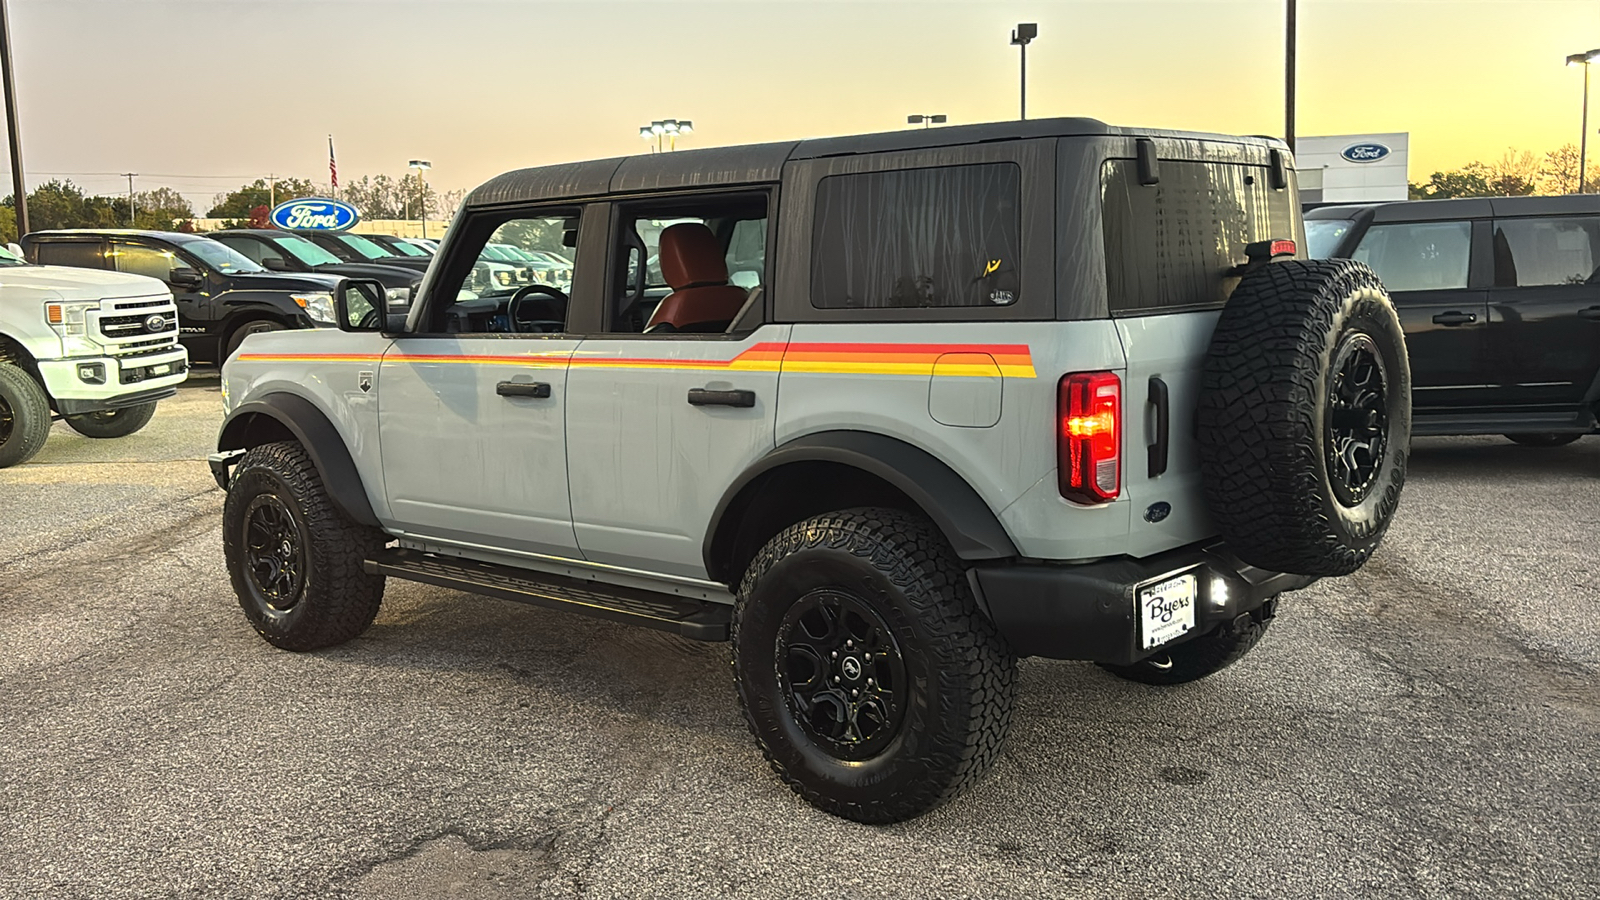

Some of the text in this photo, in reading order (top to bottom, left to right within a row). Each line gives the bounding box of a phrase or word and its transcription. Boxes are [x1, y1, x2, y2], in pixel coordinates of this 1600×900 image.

[1352, 147, 1381, 158] Ford
[286, 205, 339, 228] Ford
[1145, 596, 1190, 623] Byers
